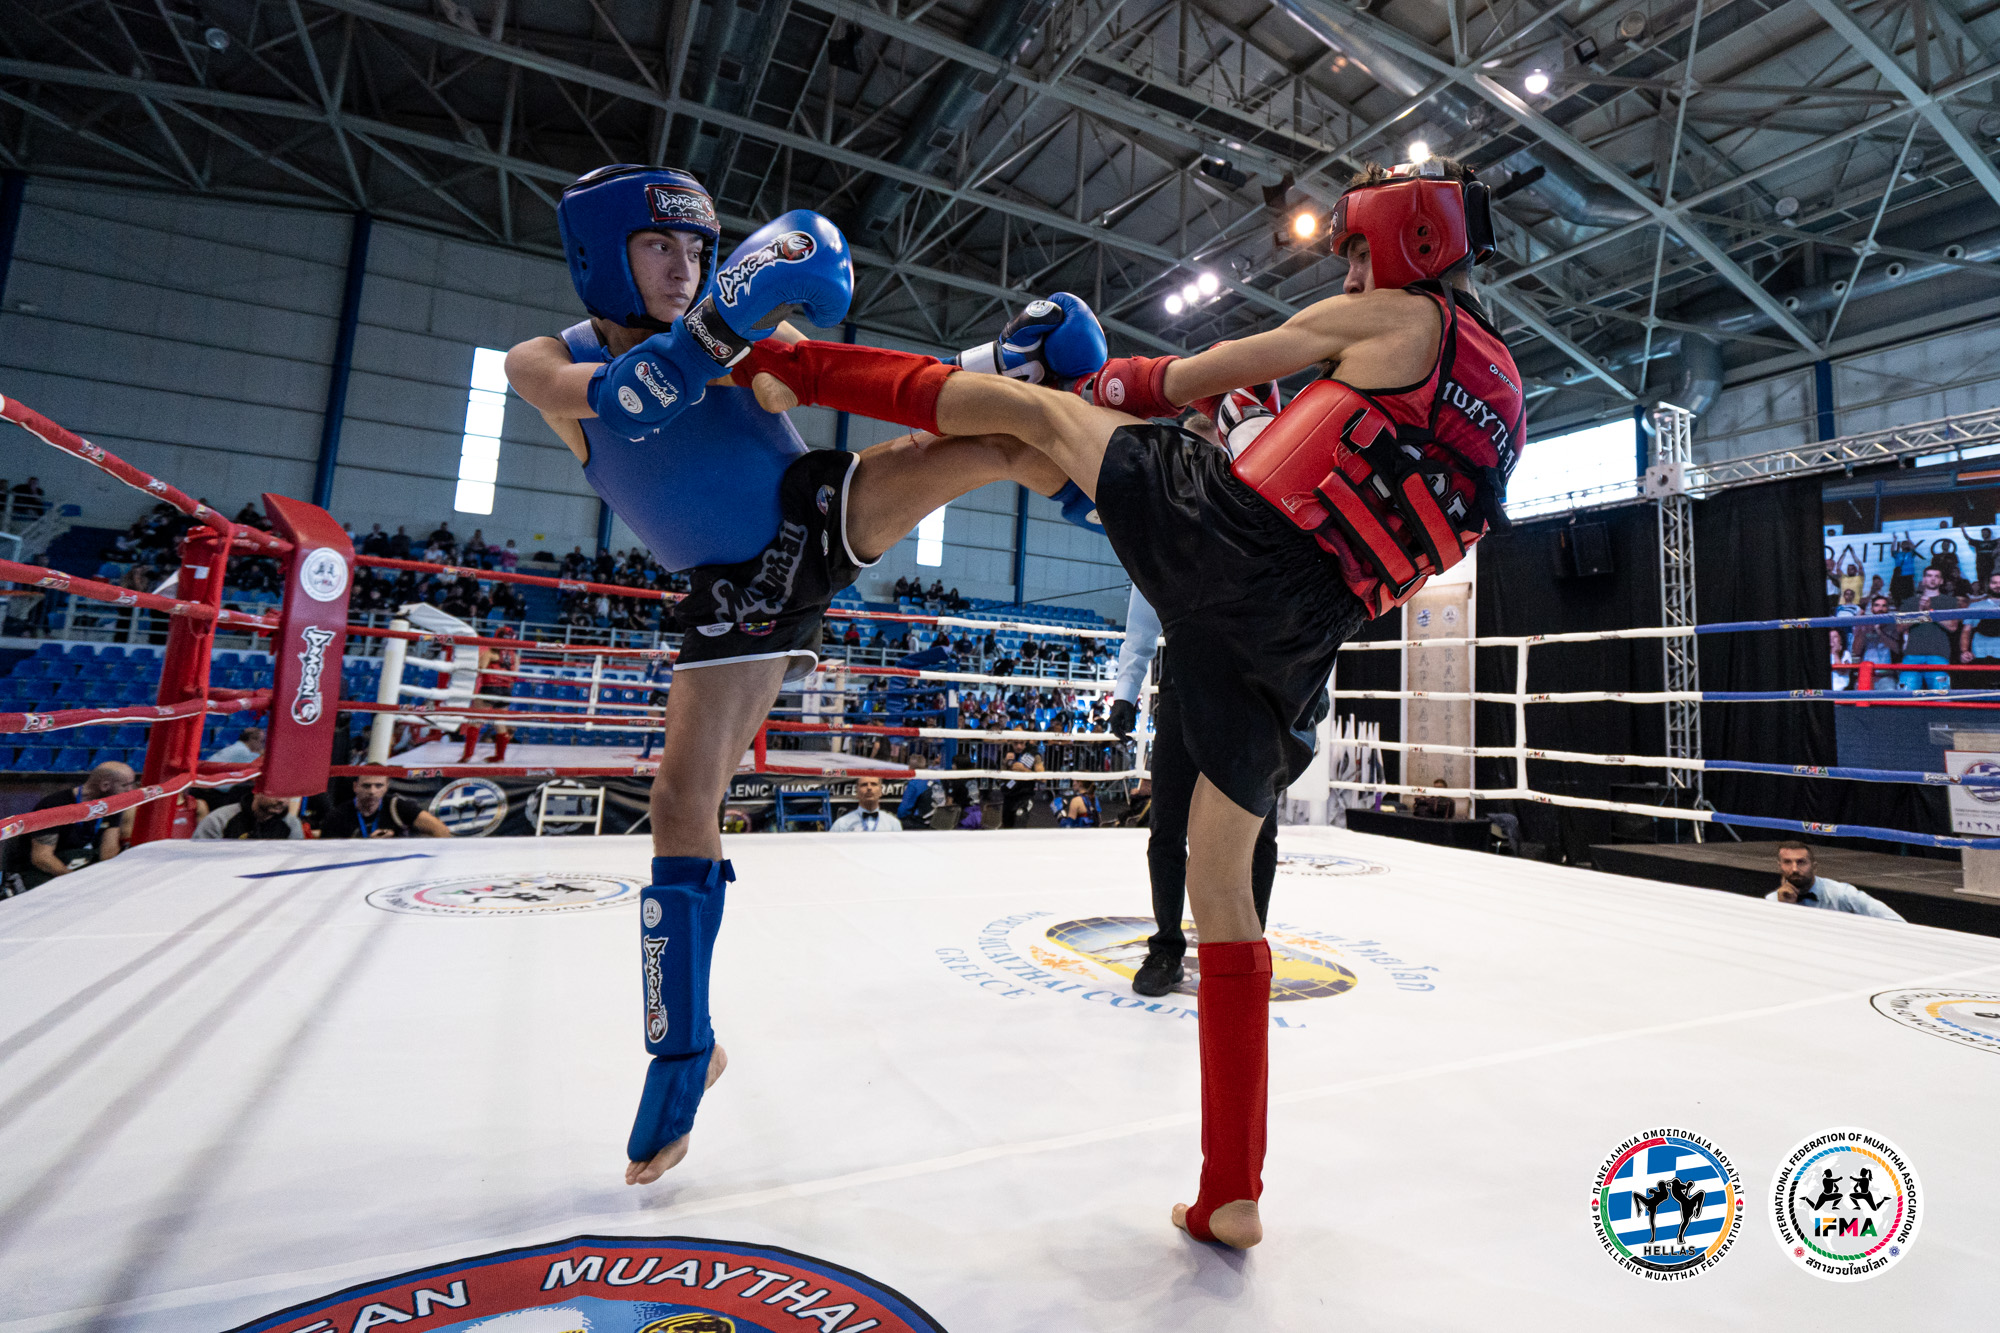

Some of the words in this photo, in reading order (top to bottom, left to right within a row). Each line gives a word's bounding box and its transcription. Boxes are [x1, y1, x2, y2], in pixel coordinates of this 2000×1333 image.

[656, 190, 704, 210] DRAGON
[718, 243, 780, 304] DRAGON
[300, 625, 337, 697] DRAGON
[645, 935, 669, 1010] DRAGON
[934, 947, 1037, 1000] GREECE
[1081, 990, 1308, 1029] COUNL
